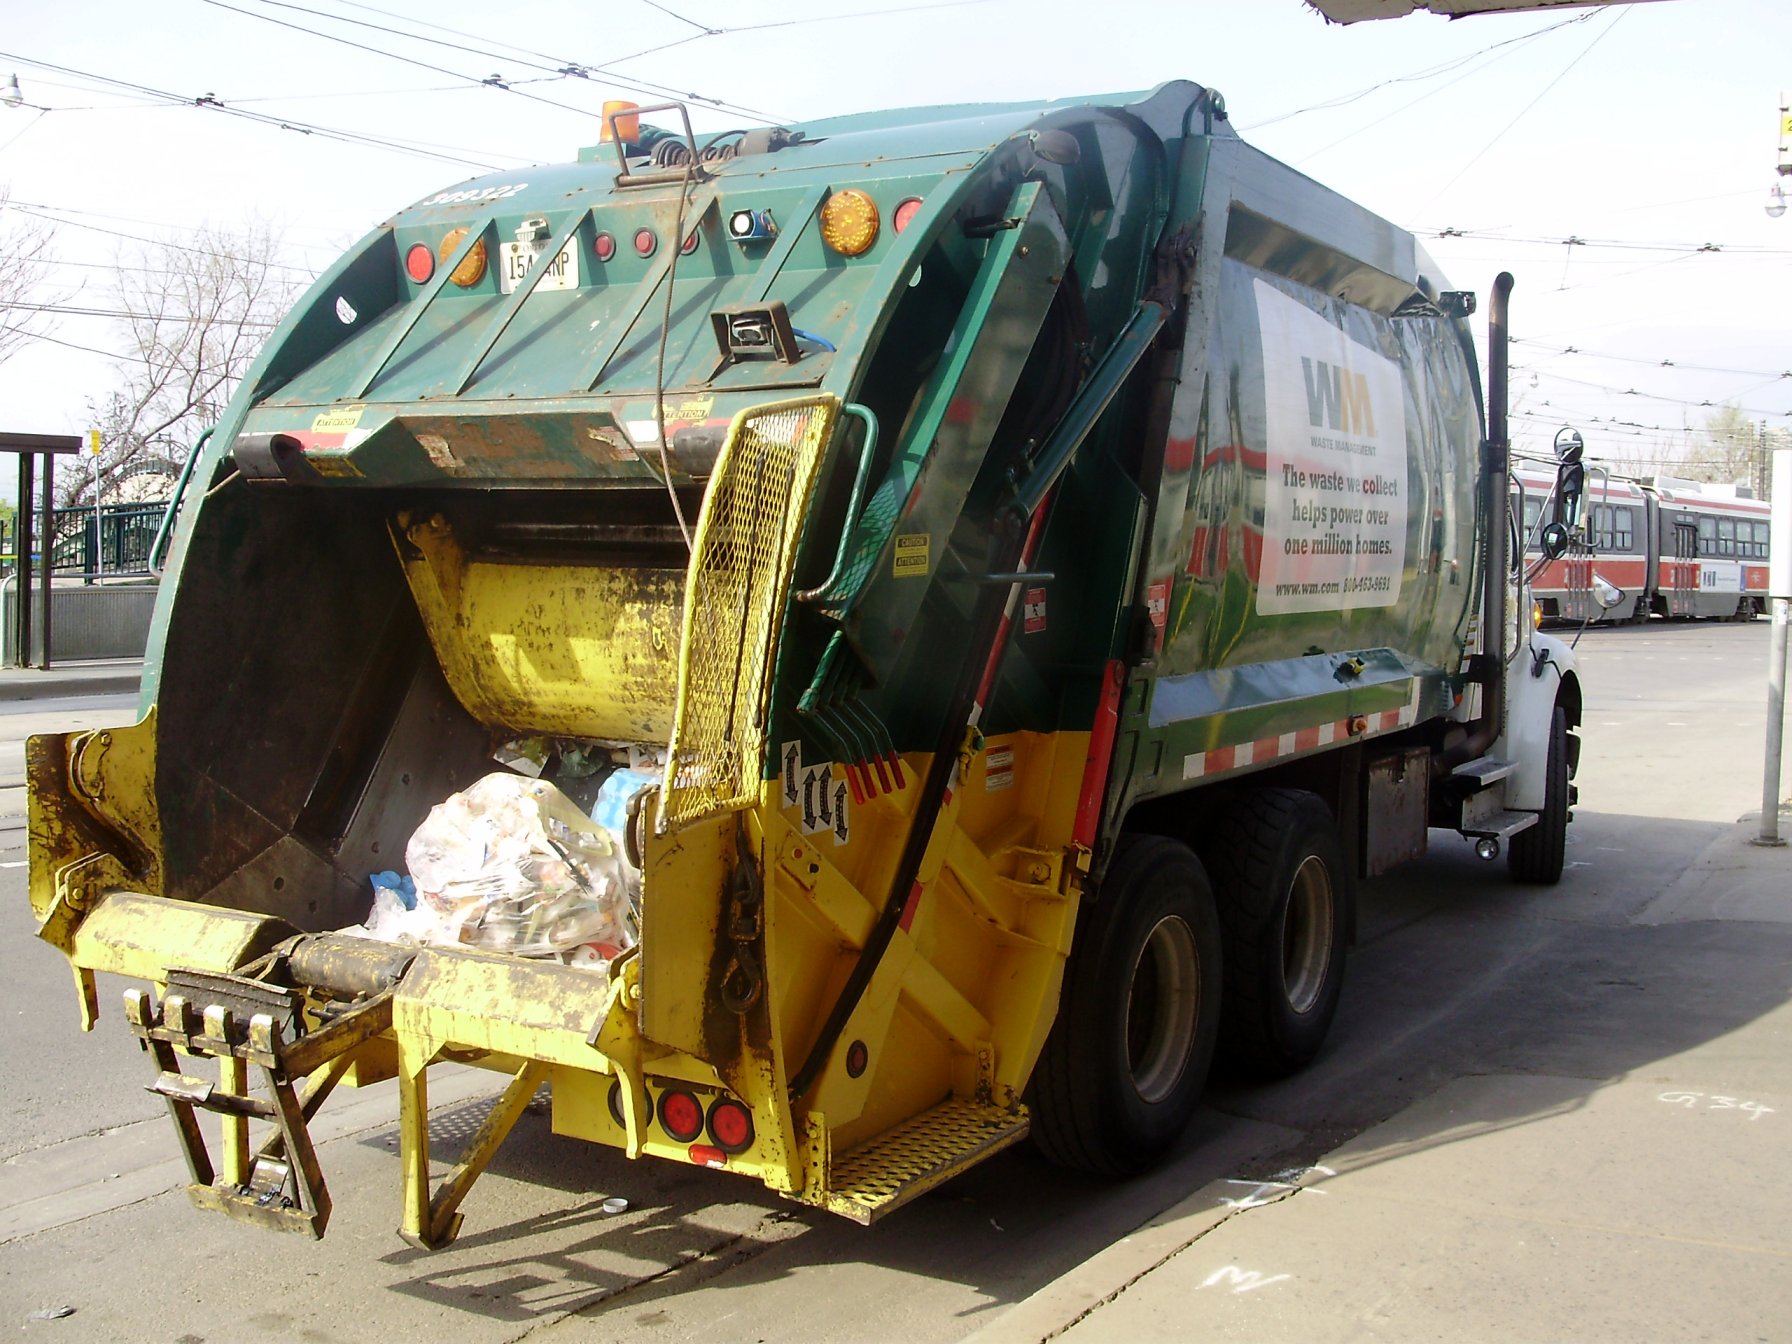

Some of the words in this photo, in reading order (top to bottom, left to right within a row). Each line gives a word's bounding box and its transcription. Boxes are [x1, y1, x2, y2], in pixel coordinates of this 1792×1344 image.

[423, 183, 529, 206] 309322
[1301, 355, 1377, 438] WM
[1310, 436, 1334, 450] WASTE
[1335, 440, 1376, 457] MANAGEMENT
[1283, 463, 1305, 488] The
[1309, 471, 1343, 491] waste
[1347, 477, 1360, 493] we
[1363, 475, 1397, 496] collect
[1292, 498, 1327, 528] helps
[1330, 506, 1363, 529] power
[1366, 508, 1389, 525] over
[901, 538, 925, 547] CAUTION
[1284, 537, 1308, 555] one
[1311, 533, 1352, 555] million
[1355, 534, 1392, 555] homes.
[897, 556, 926, 566] ATTENTION
[1276, 582, 1339, 596] www.wm.com
